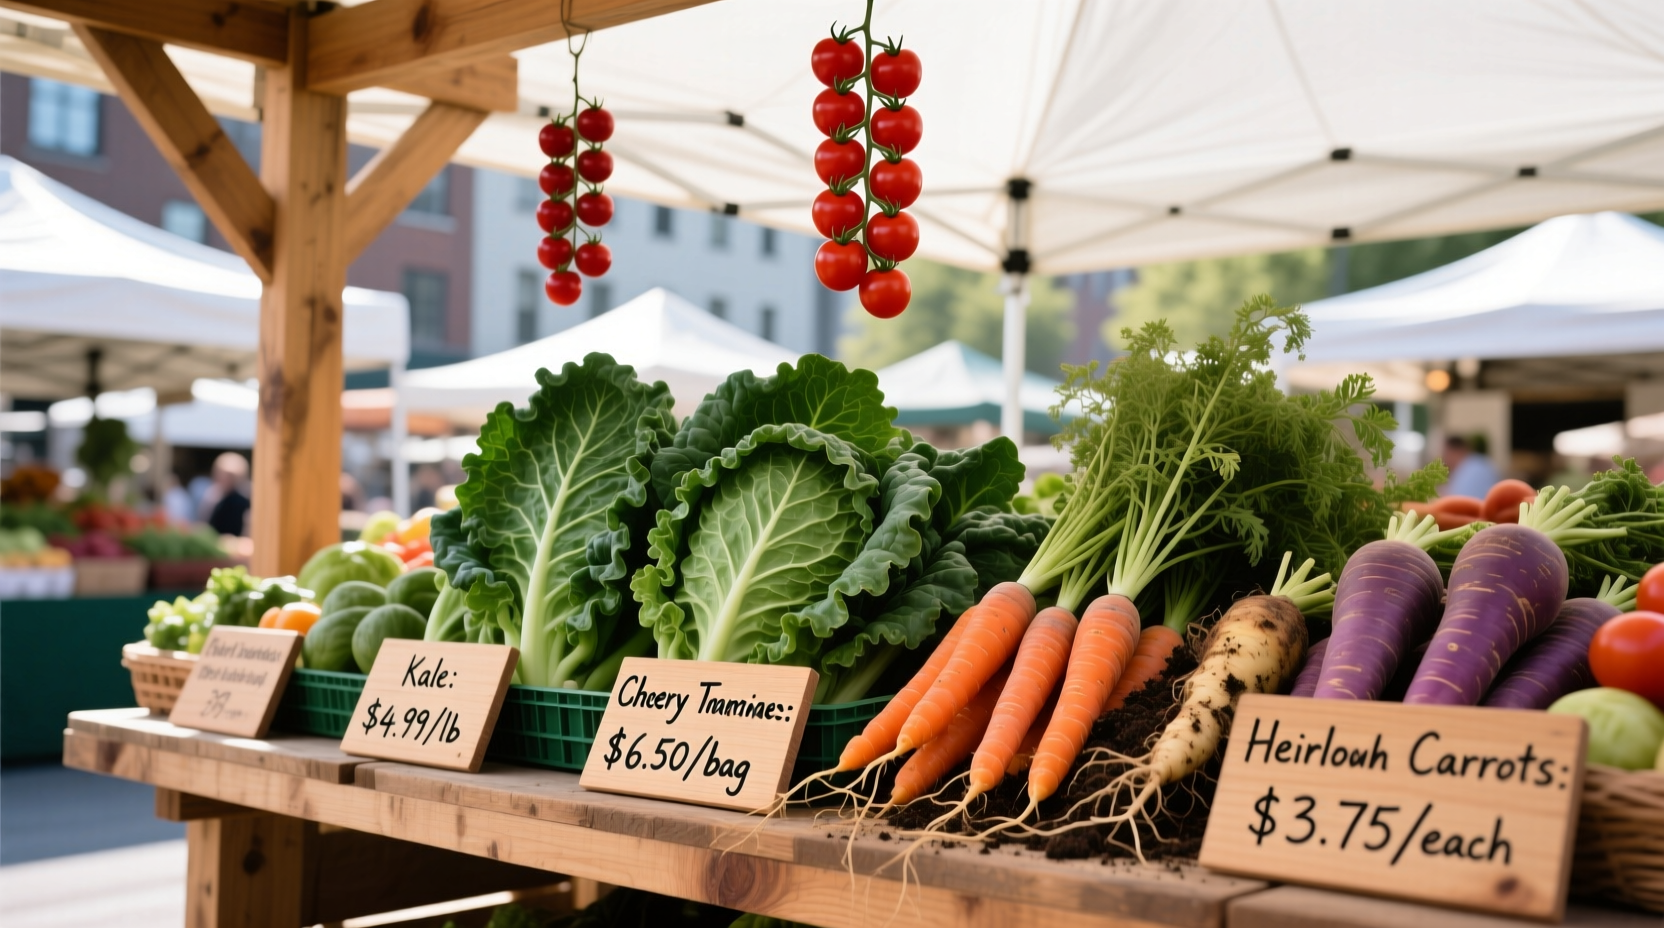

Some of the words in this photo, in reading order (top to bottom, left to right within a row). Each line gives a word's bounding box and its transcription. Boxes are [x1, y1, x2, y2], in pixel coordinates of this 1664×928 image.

[402, 654, 457, 689] Kale:
[362, 697, 461, 745] $4.99/lb
[604, 727, 750, 797] $6.50/bag
[1409, 732, 1569, 790] Carrots:
[1248, 786, 1512, 866] $3.75/each
